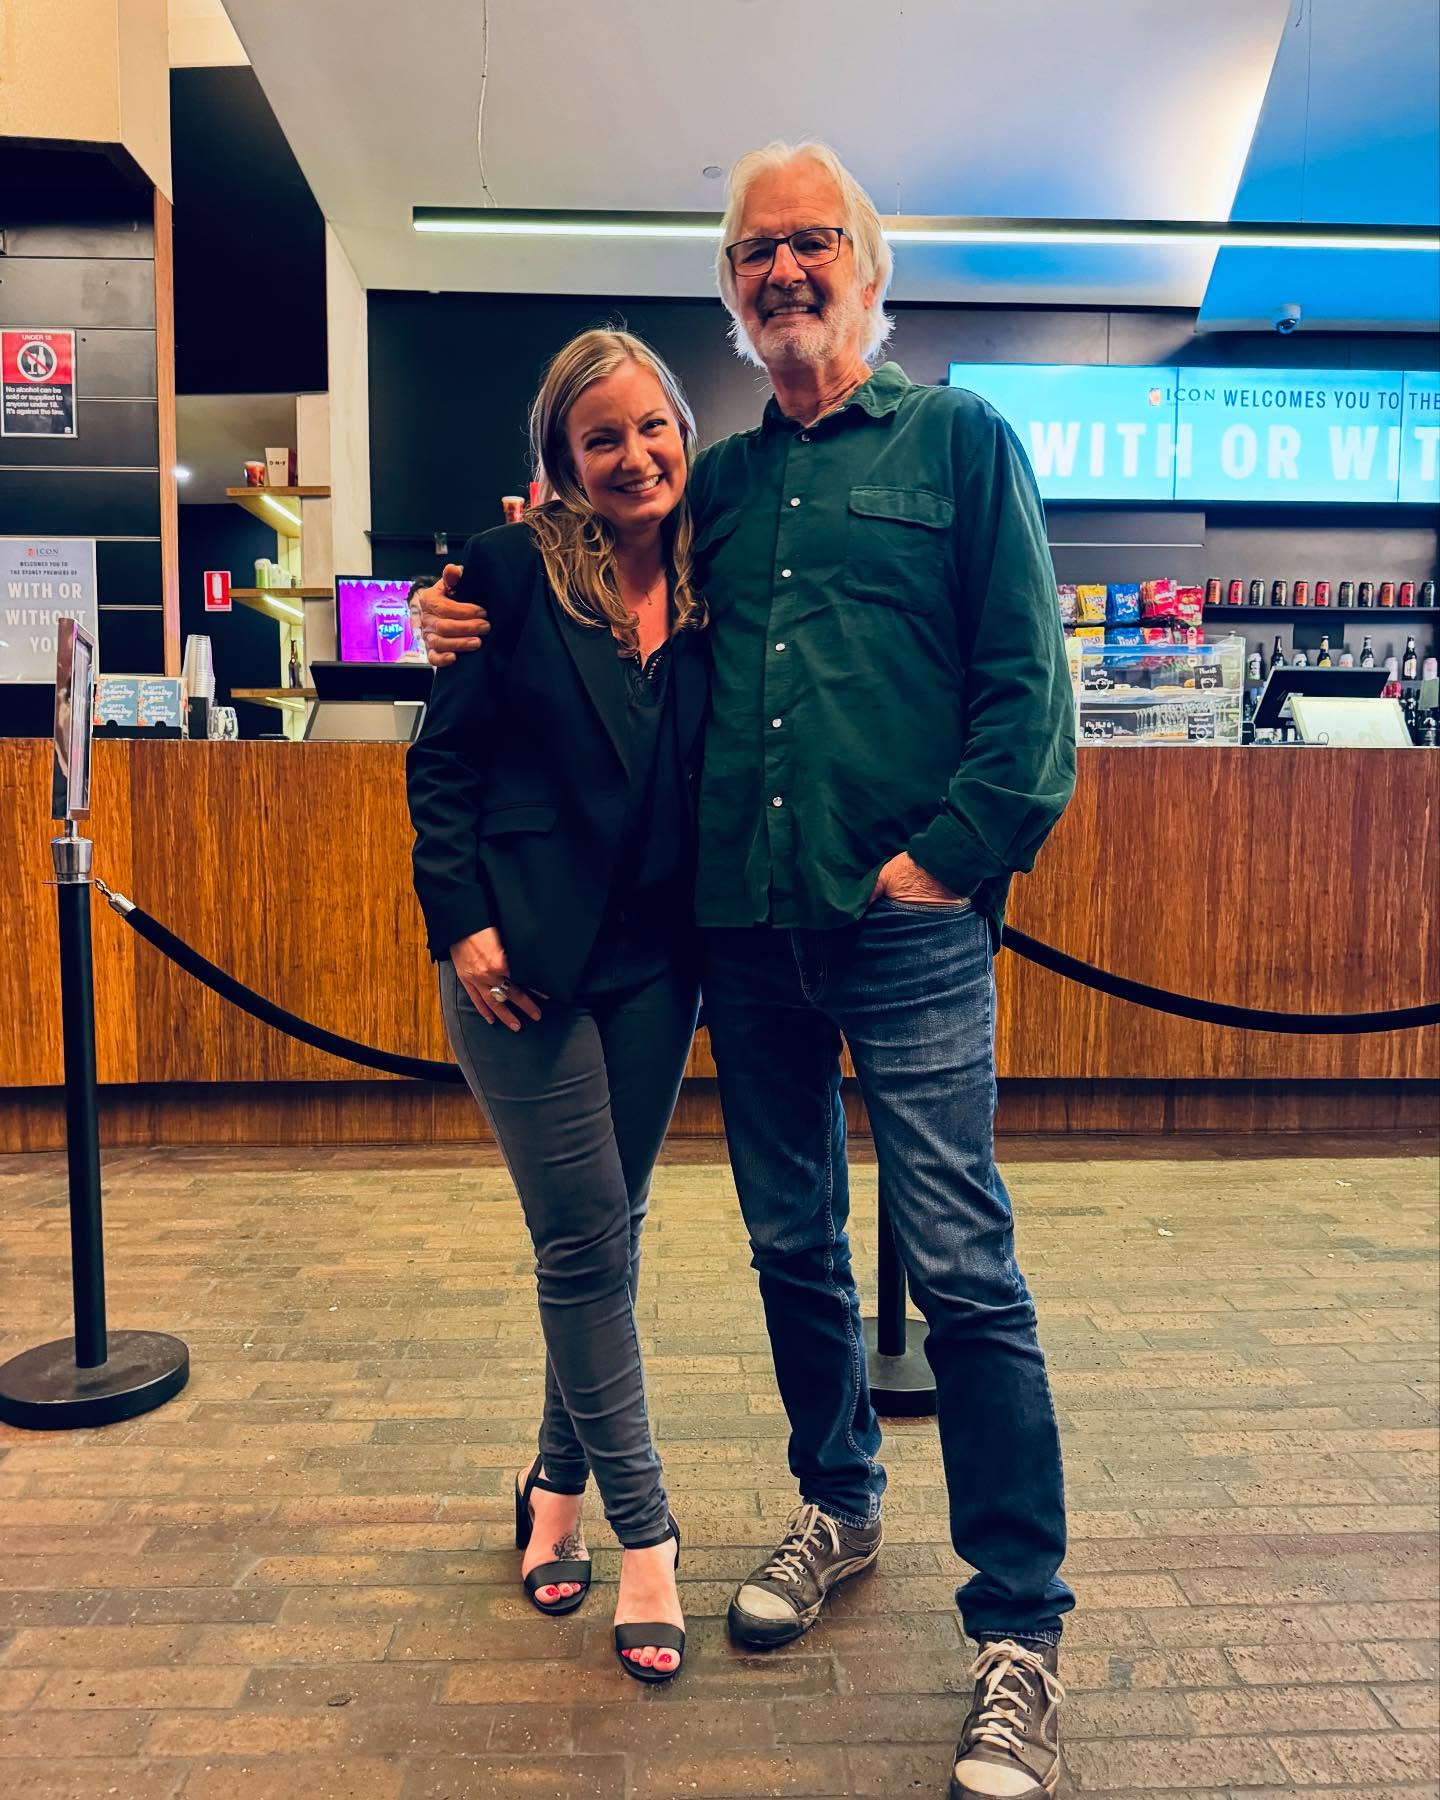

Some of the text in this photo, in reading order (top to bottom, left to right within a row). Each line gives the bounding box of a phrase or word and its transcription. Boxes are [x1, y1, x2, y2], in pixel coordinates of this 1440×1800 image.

[1166, 388, 1440, 410] ICON WELCOMES YOU TO THE
[16, 408, 39, 416] against
[1029, 421, 1193, 479] WITH
[1221, 423, 1301, 480] OR
[7, 582, 82, 599] WITH OR
[30, 636, 58, 652] YO
